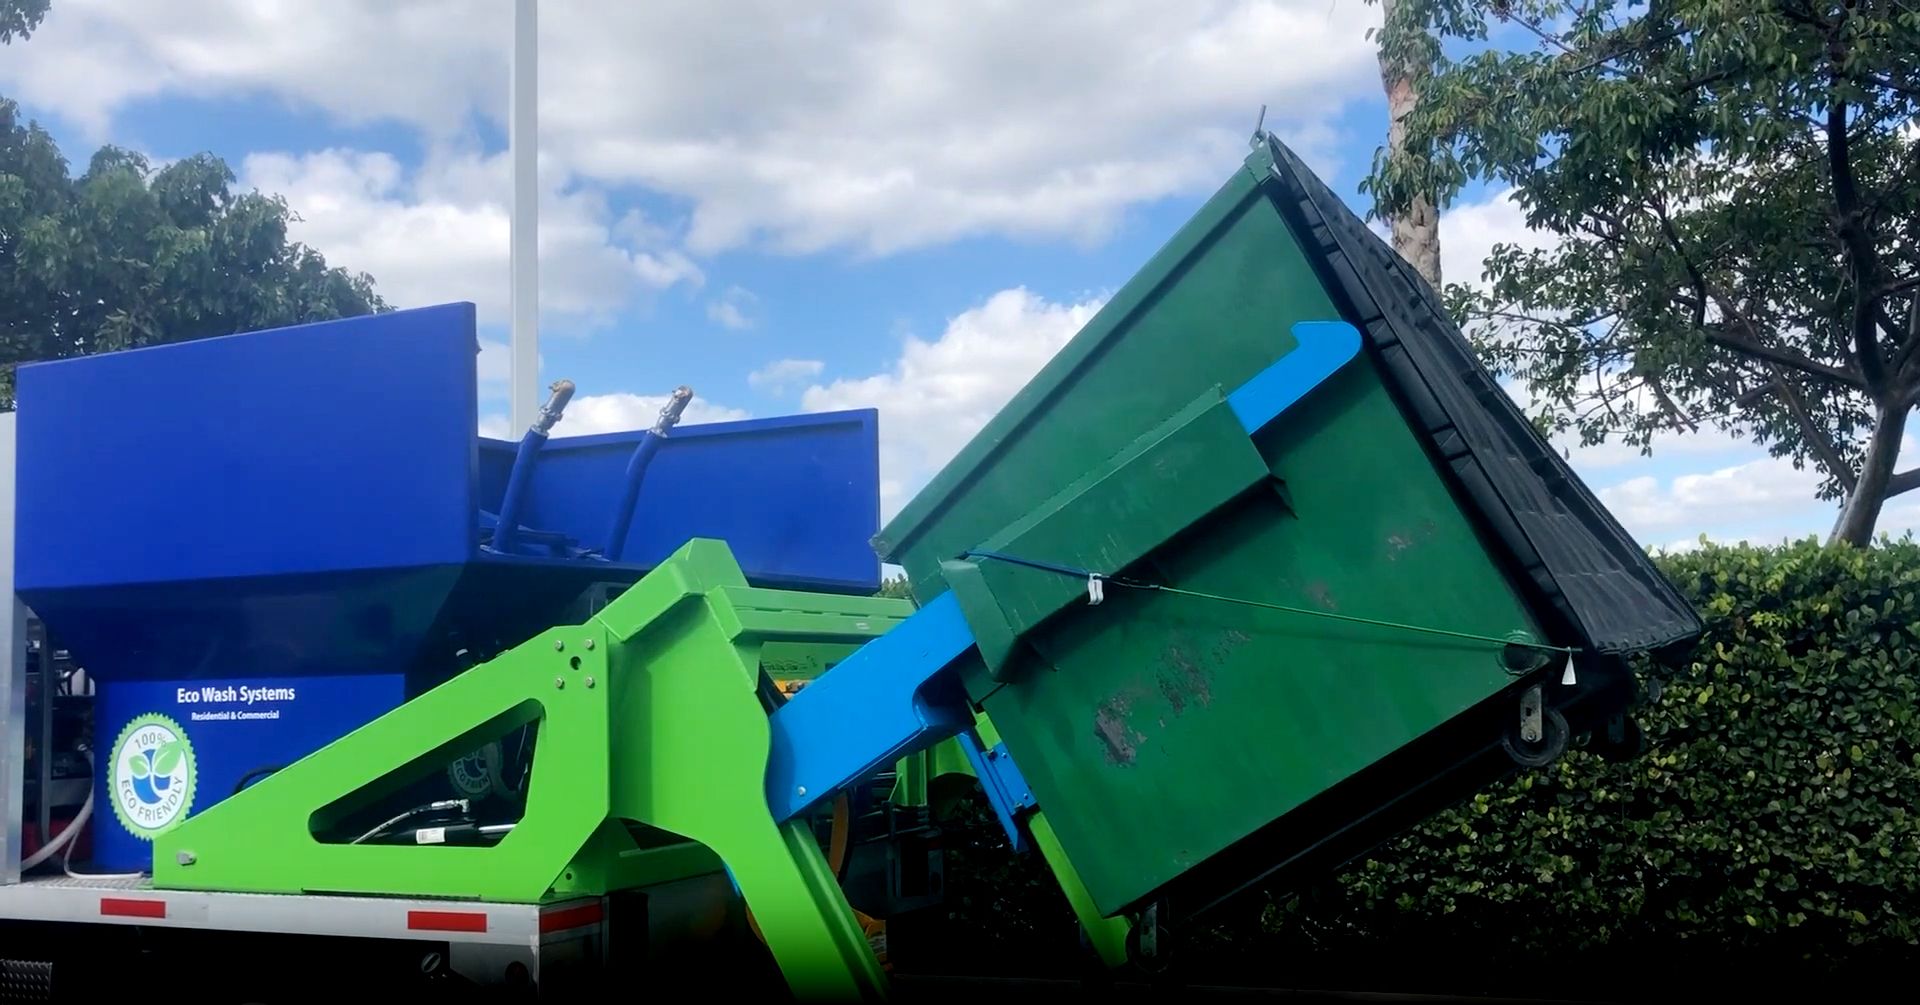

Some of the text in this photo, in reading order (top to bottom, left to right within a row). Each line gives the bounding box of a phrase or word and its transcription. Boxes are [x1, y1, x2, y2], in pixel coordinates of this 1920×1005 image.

[177, 685, 295, 705] Eco Wash Systems
[191, 710, 280, 720] Residential & Commercial
[135, 732, 167, 748] 100%
[121, 777, 183, 821] ECO FRIENDLY
